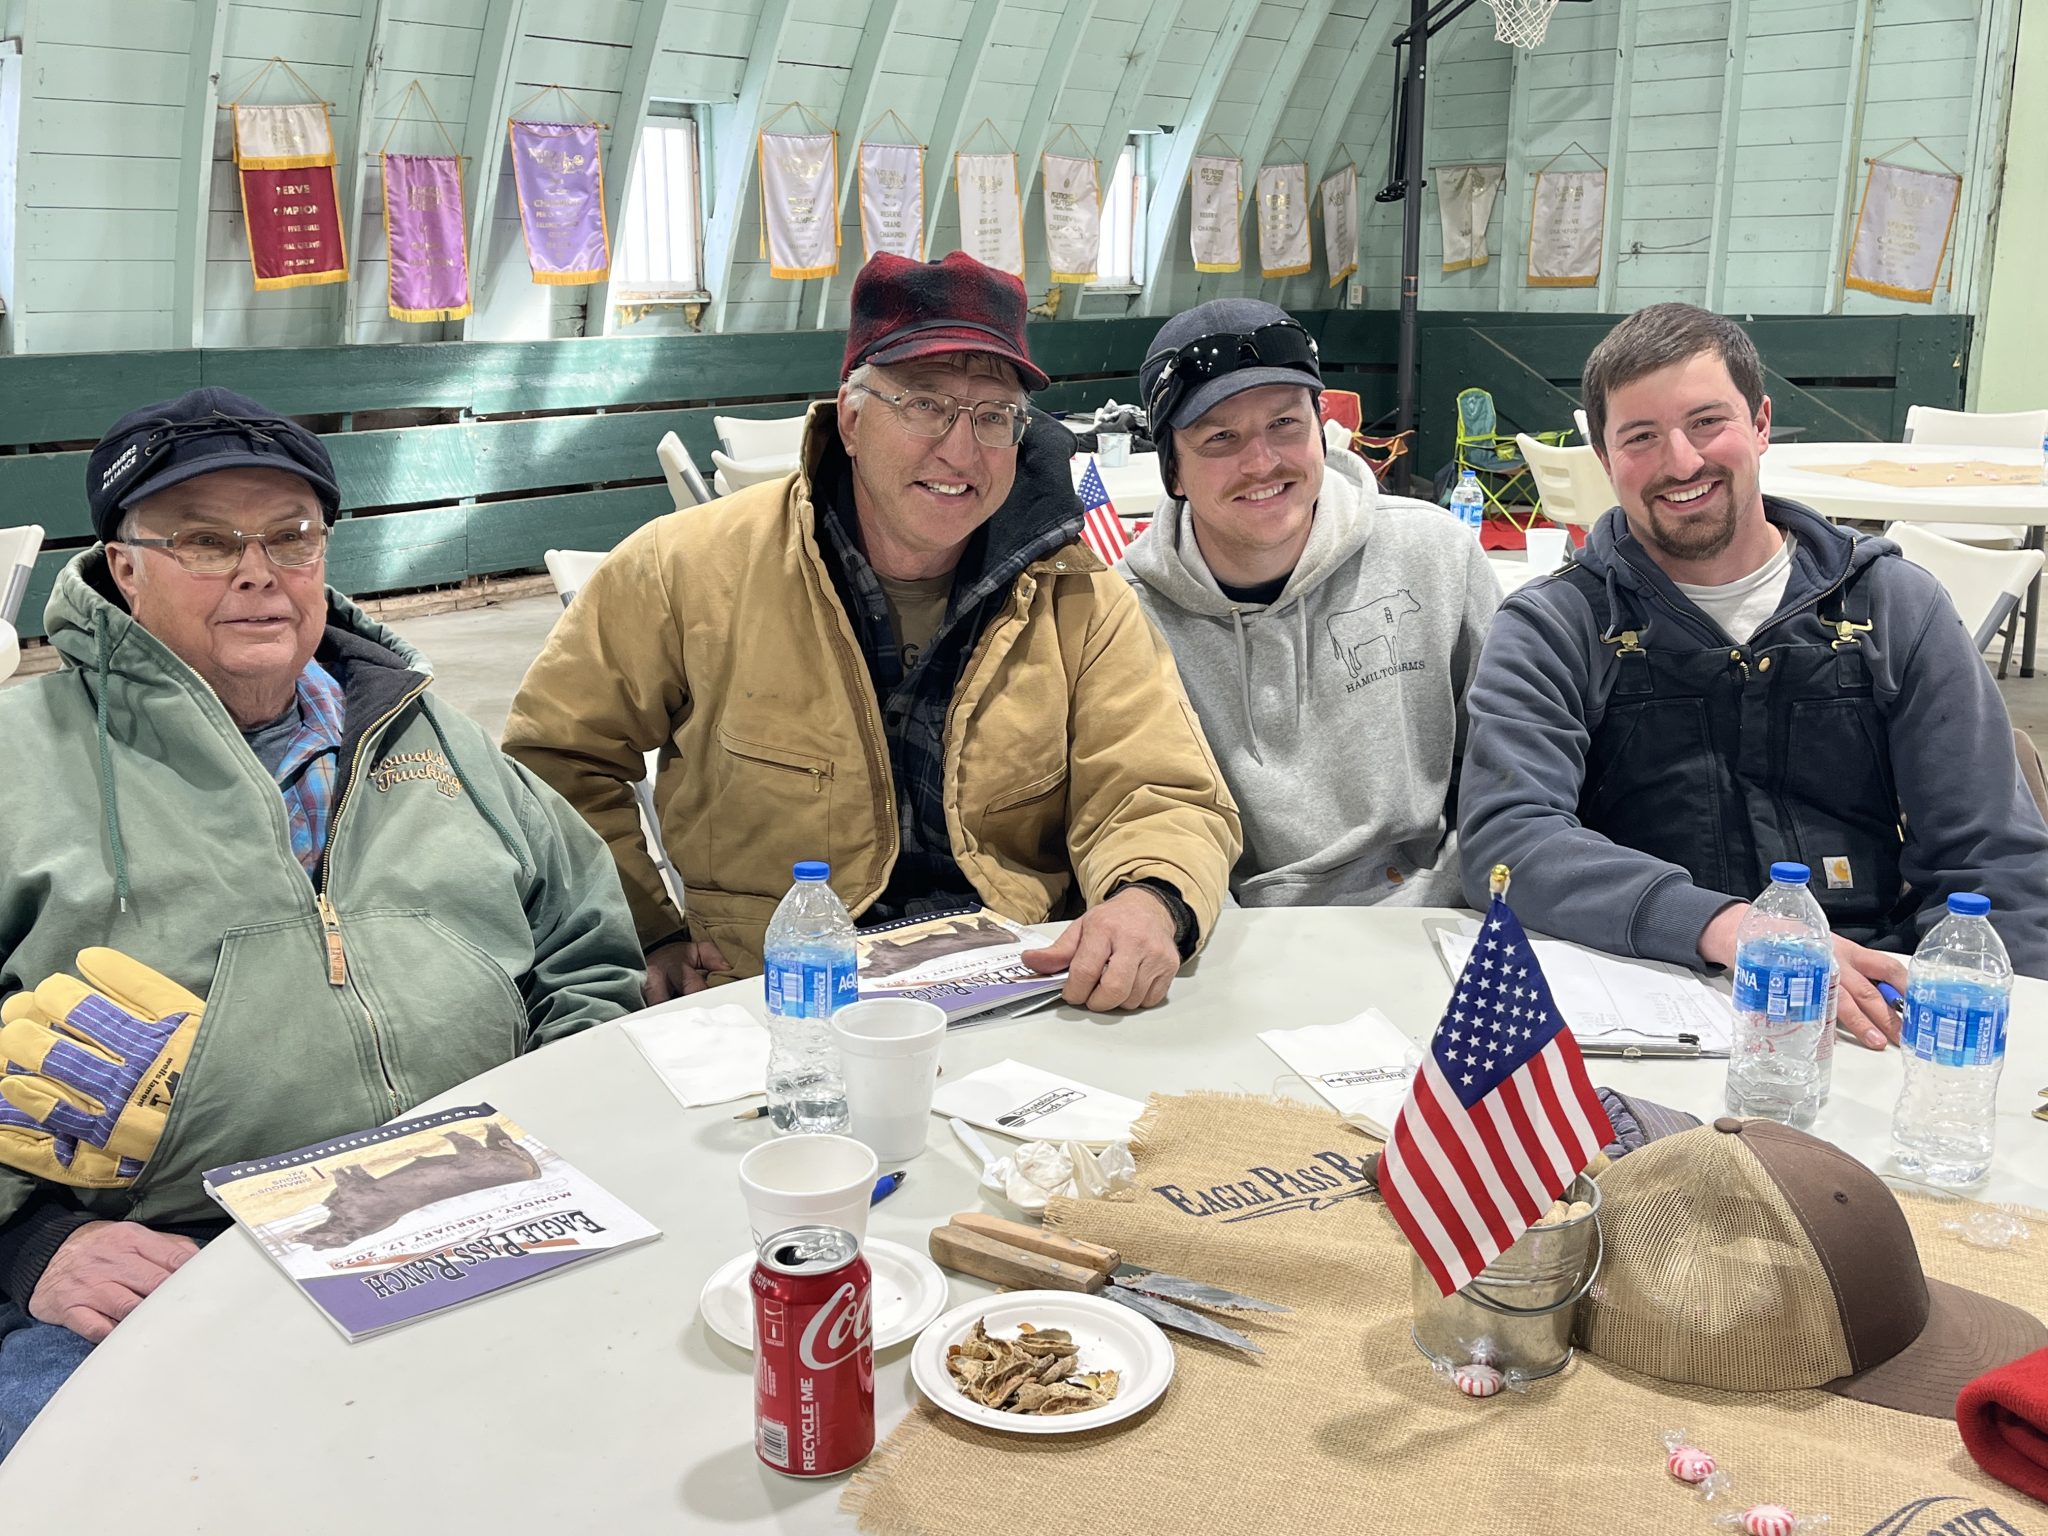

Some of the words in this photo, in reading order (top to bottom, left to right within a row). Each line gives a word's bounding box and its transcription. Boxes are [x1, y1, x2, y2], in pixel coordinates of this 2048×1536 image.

[101, 455, 137, 490] ALLIANCE
[1345, 667, 1397, 694] HAMILTO
[377, 763, 462, 793] Trucking
[818, 971, 826, 1018] RECYCLE
[838, 970, 858, 994] AQU
[963, 971, 1017, 992] PASS
[1979, 1016, 1992, 1065] RECYCLE
[271, 1173, 309, 1186] ANGUS
[1151, 1180, 1268, 1217] EAGLE
[1246, 1165, 1342, 1200] PASS
[497, 1191, 573, 1215] MONDAY,
[413, 1212, 494, 1242] FEBRUARY
[515, 1209, 607, 1245] EAGLE
[332, 1250, 377, 1271] 2025
[381, 1239, 406, 1252] 17,
[452, 1229, 529, 1266] PASS
[361, 1253, 466, 1300] RANCH
[800, 1377, 814, 1403] ME
[800, 1404, 816, 1472] RECYCLE
